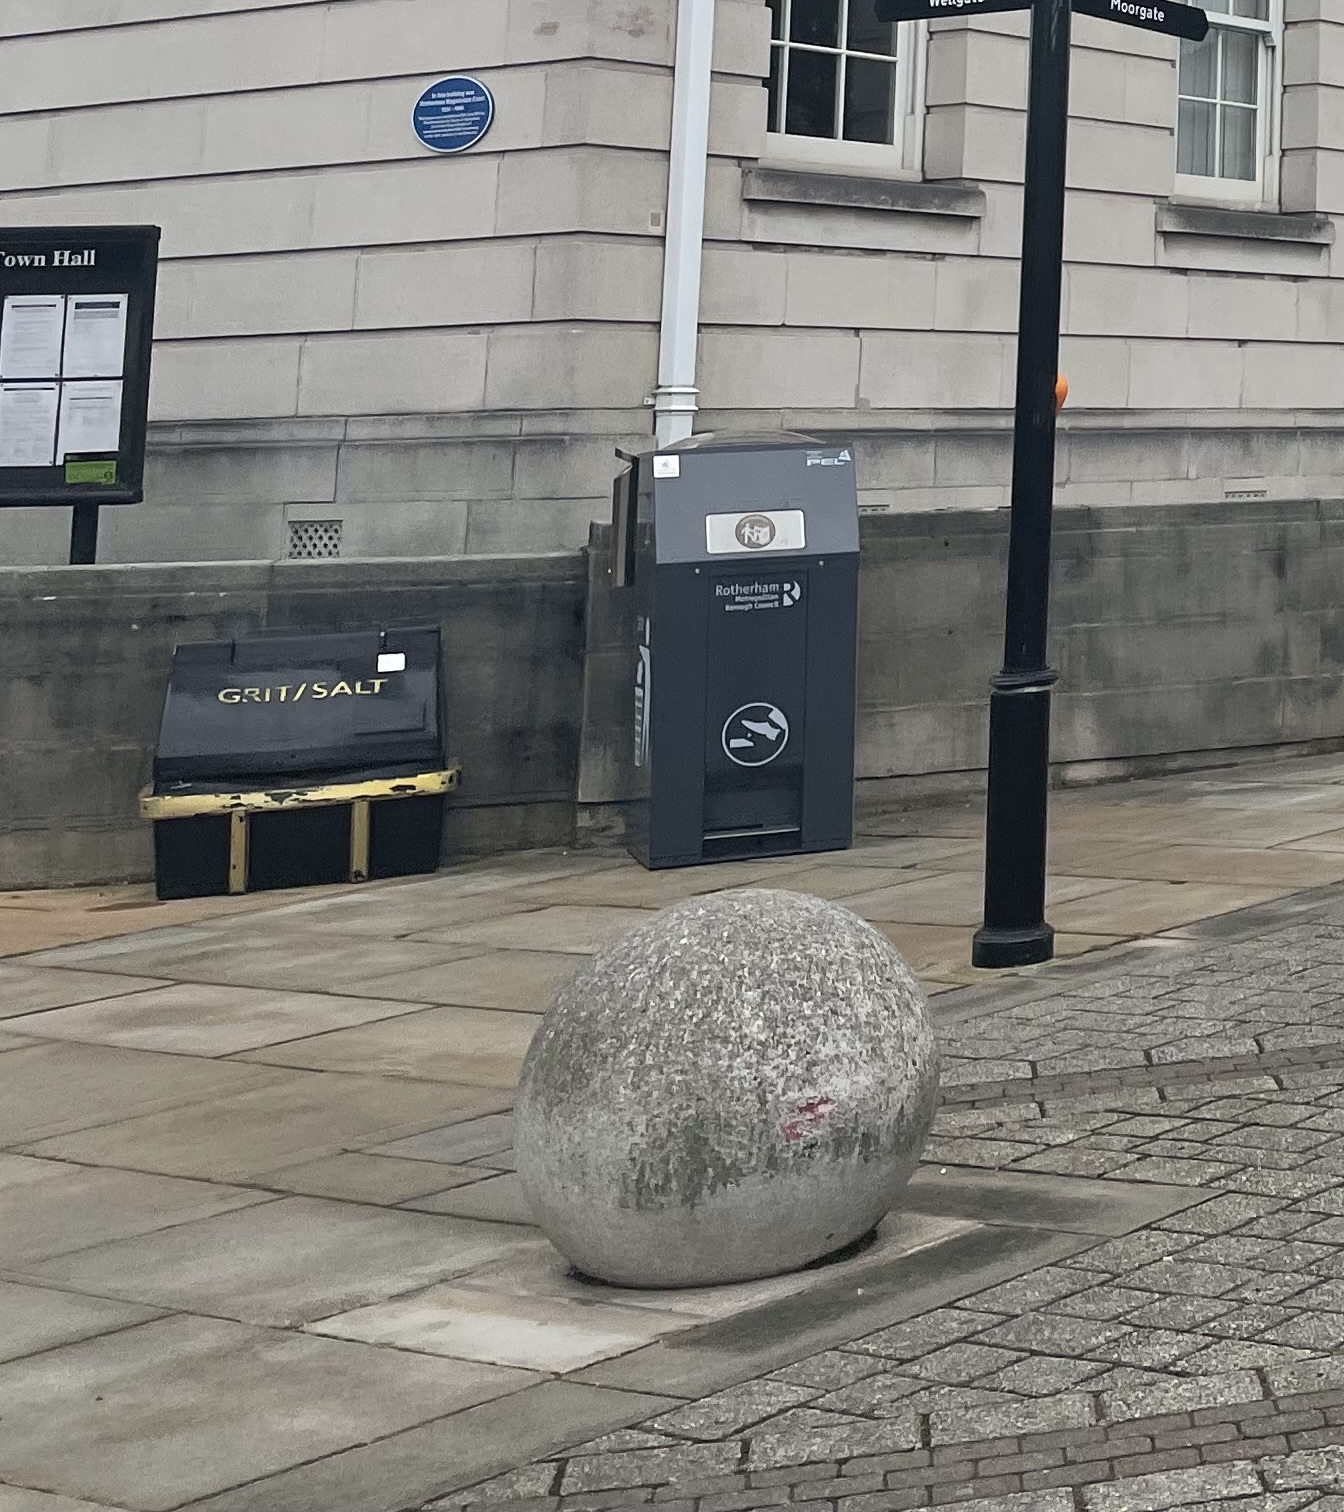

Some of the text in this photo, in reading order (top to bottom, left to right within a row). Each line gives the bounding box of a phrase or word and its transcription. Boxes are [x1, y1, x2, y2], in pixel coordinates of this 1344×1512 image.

[53, 250, 95, 266] Hall
[716, 581, 780, 596] Rotherham
[218, 679, 388, 704] GRIT/SALT
